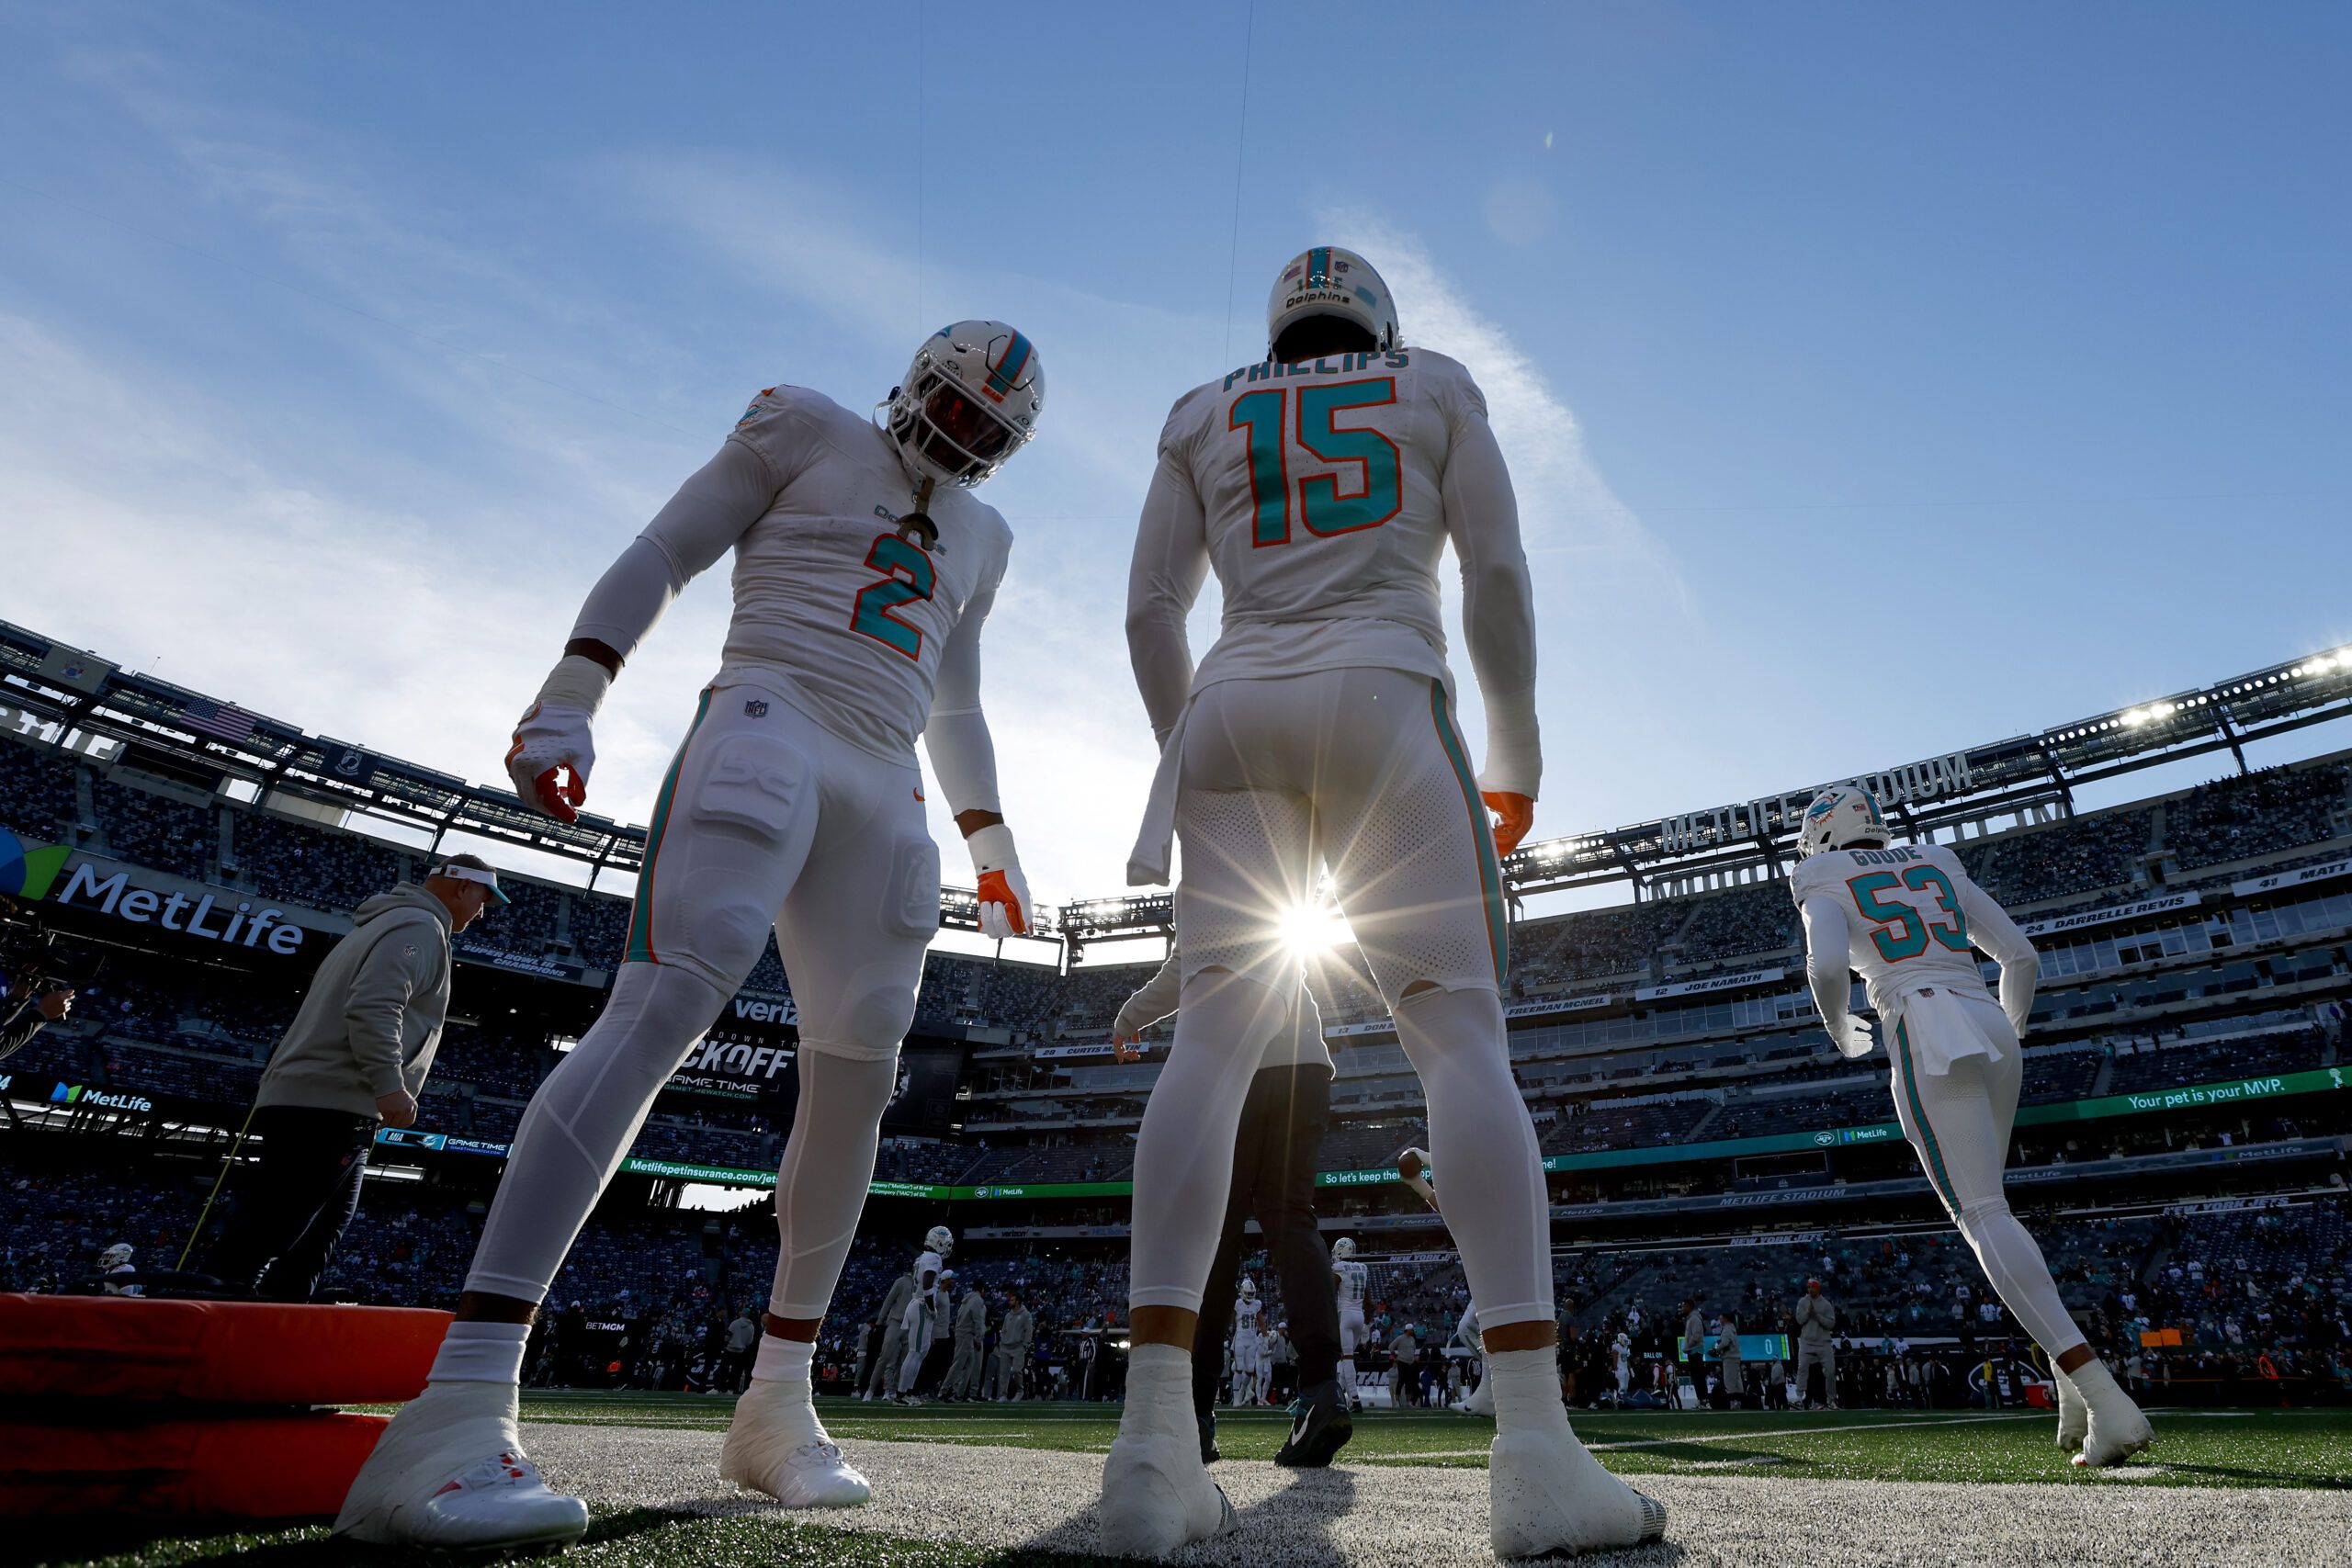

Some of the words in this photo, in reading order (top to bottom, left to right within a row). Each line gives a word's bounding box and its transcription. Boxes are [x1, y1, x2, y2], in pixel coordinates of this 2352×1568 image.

[1286, 290, 1351, 308] Dolphins
[1224, 348, 1408, 392] PHILLIPS
[1229, 377, 1403, 548] 15
[849, 533, 936, 662] 2
[1661, 794, 1803, 853] METLIFE
[1813, 751, 1974, 809] ADIUM
[2259, 877, 2278, 887] 41
[2301, 863, 2350, 880] MATT
[57, 863, 303, 954] MetLife
[1845, 864, 1972, 964] 53
[2025, 924, 2044, 934] 24
[2054, 908, 2134, 929] DARRELLE
[2136, 897, 2185, 912] REVIS
[461, 944, 505, 959] SUPER
[505, 953, 539, 965] BOWL
[492, 958, 567, 977] CHAMPIONS
[1685, 982, 1709, 992] JOE
[1711, 974, 1761, 988] NAMATH
[736, 999, 797, 1026] veriz
[1508, 1003, 1562, 1015] FREEMAN
[1563, 998, 1605, 1010] MCNEIL
[1364, 1023, 1385, 1032] DON
[680, 1040, 796, 1079] CKOFF
[1067, 1046, 1102, 1055] CURTIS
[667, 1074, 713, 1088] AME
[716, 1079, 762, 1094] TIME
[82, 1089, 152, 1111] MetLife
[2129, 1096, 2161, 1110] Your
[2165, 1092, 2189, 1107] pet
[2192, 1089, 2204, 1101] is
[2206, 1086, 2241, 1102] your
[2244, 1079, 2285, 1095] MVP.
[388, 1131, 404, 1142] MIA
[1857, 1129, 1887, 1139] MetLife
[447, 1138, 480, 1148] GAME
[481, 1142, 507, 1151] TIME
[2239, 1146, 2302, 1158] MetLife
[1326, 1174, 1337, 1183] So
[1340, 1174, 1357, 1183] let's
[1360, 1172, 1381, 1182] keep
[2006, 1168, 2063, 1181] MetLife
[1720, 1194, 1779, 1205] METLIFE
[1782, 1189, 1846, 1201] STADIUM
[2202, 1200, 2244, 1211] YORK
[1401, 1217, 1442, 1225] MetLife
[1730, 1236, 1758, 1245] NEW
[1762, 1235, 1792, 1244] YORK
[1411, 1253, 1441, 1261] YORK
[1351, 1272, 1365, 1300] 11
[585, 1322, 626, 1331] BETMGM
